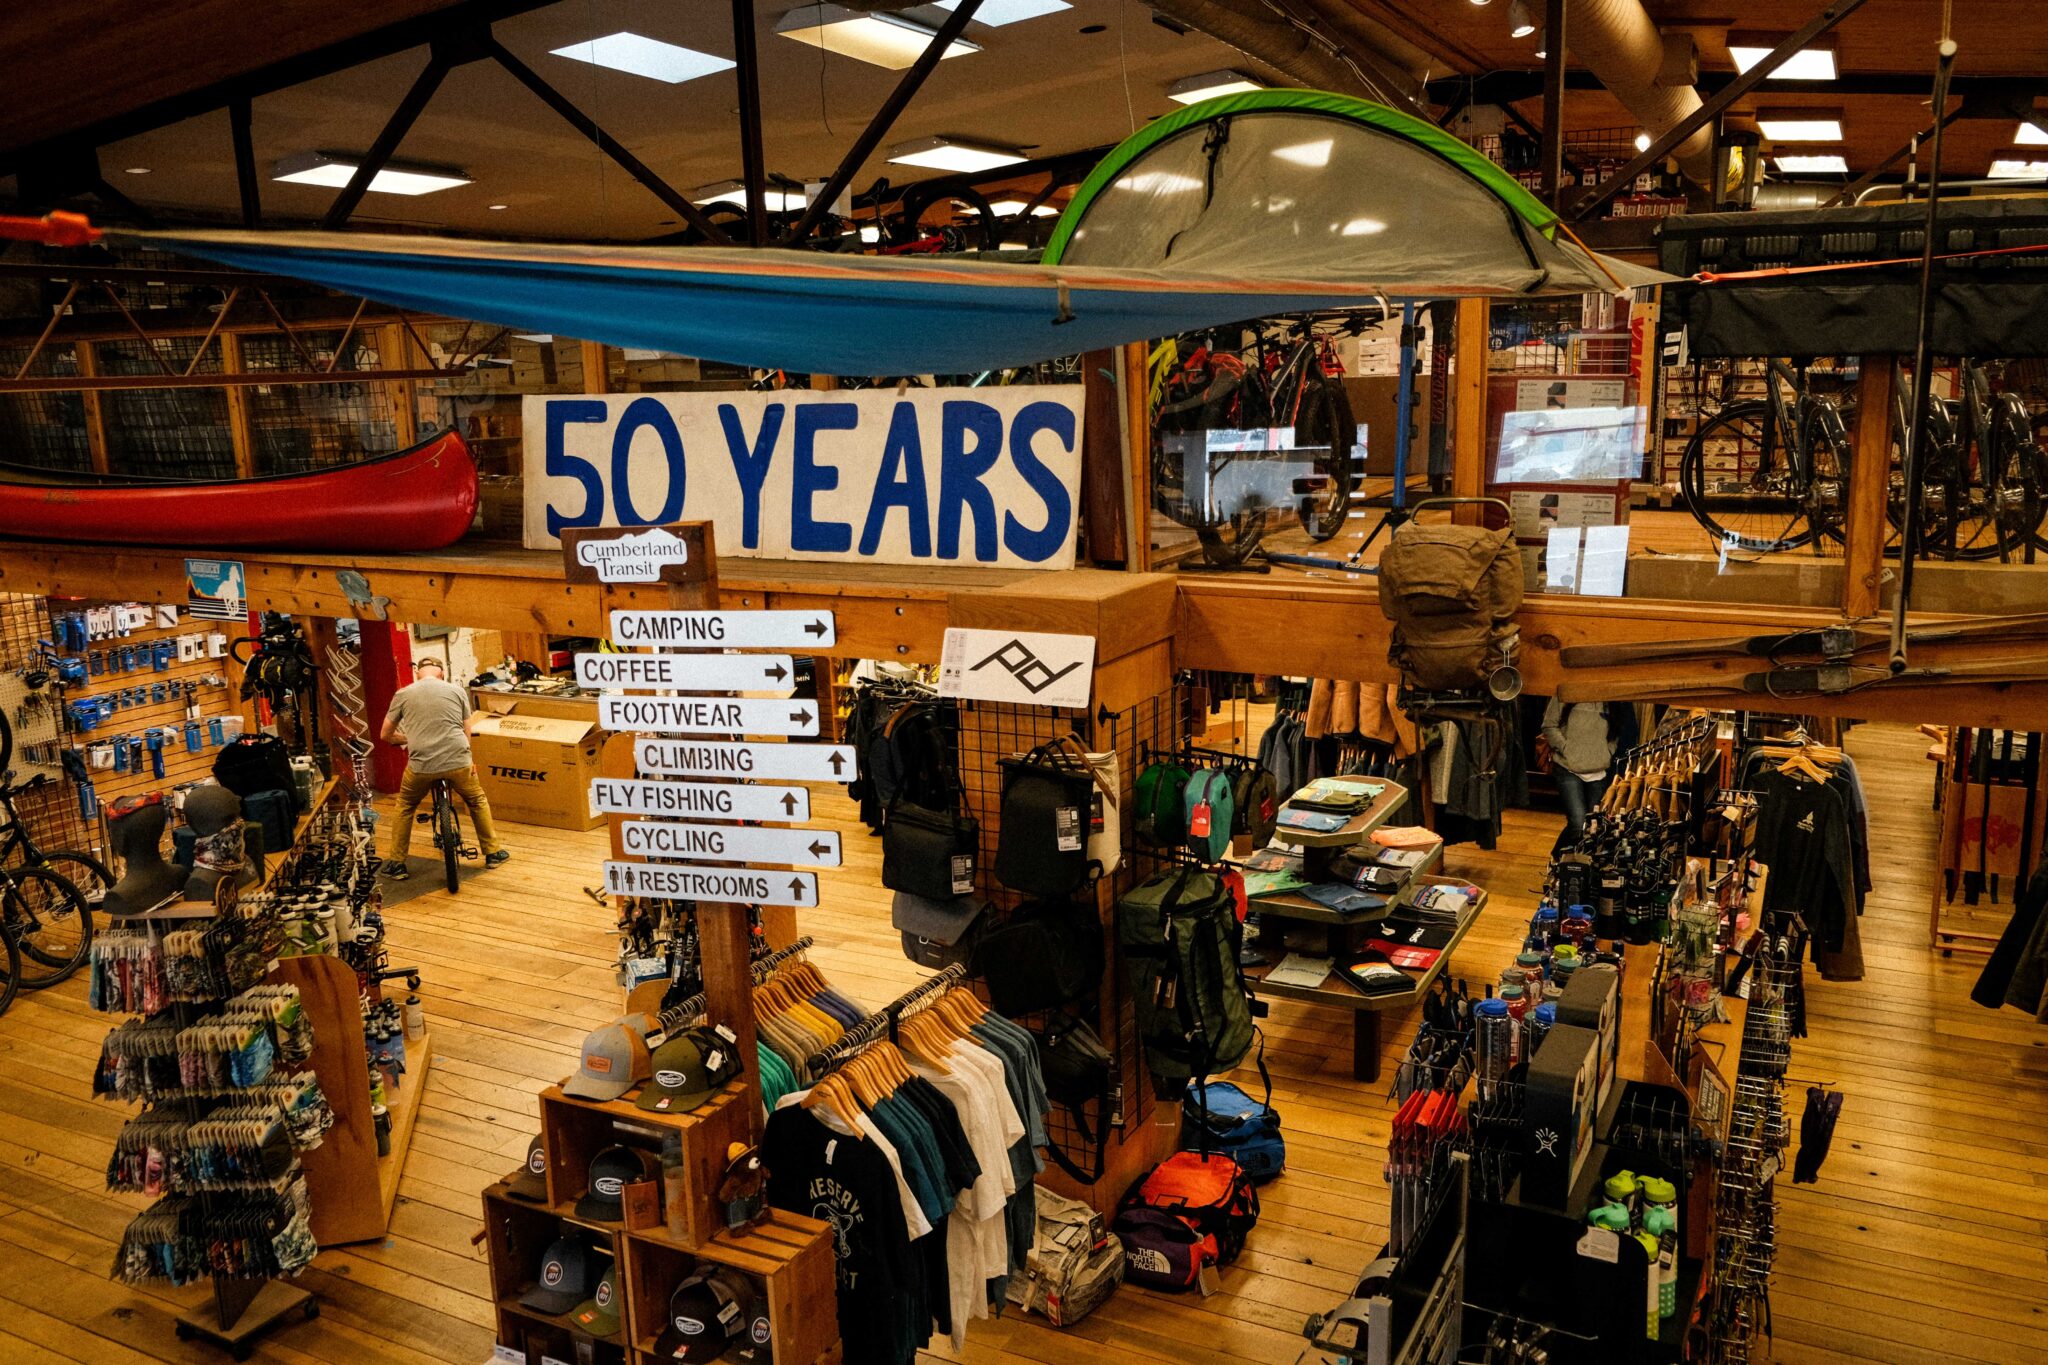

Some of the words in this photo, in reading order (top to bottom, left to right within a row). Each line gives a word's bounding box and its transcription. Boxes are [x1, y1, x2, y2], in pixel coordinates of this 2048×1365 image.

[546, 396, 686, 539] 50
[717, 400, 1076, 562] YEARS
[581, 541, 684, 564] Cumberland
[598, 558, 655, 577] Transit
[619, 616, 725, 640] CAMPING
[584, 658, 673, 683] COFFEE
[610, 701, 743, 727] FOOTWEAR
[644, 744, 753, 771] CLIMBING
[488, 765, 548, 781] TREK
[596, 784, 635, 807] FLY
[642, 787, 733, 812] FISHING
[626, 826, 725, 854] CYCLING
[639, 870, 769, 898] RESTROOMS
[1126, 1250, 1155, 1264] NORTH
[1137, 1247, 1155, 1258] THE
[1133, 1260, 1155, 1272] FACE
